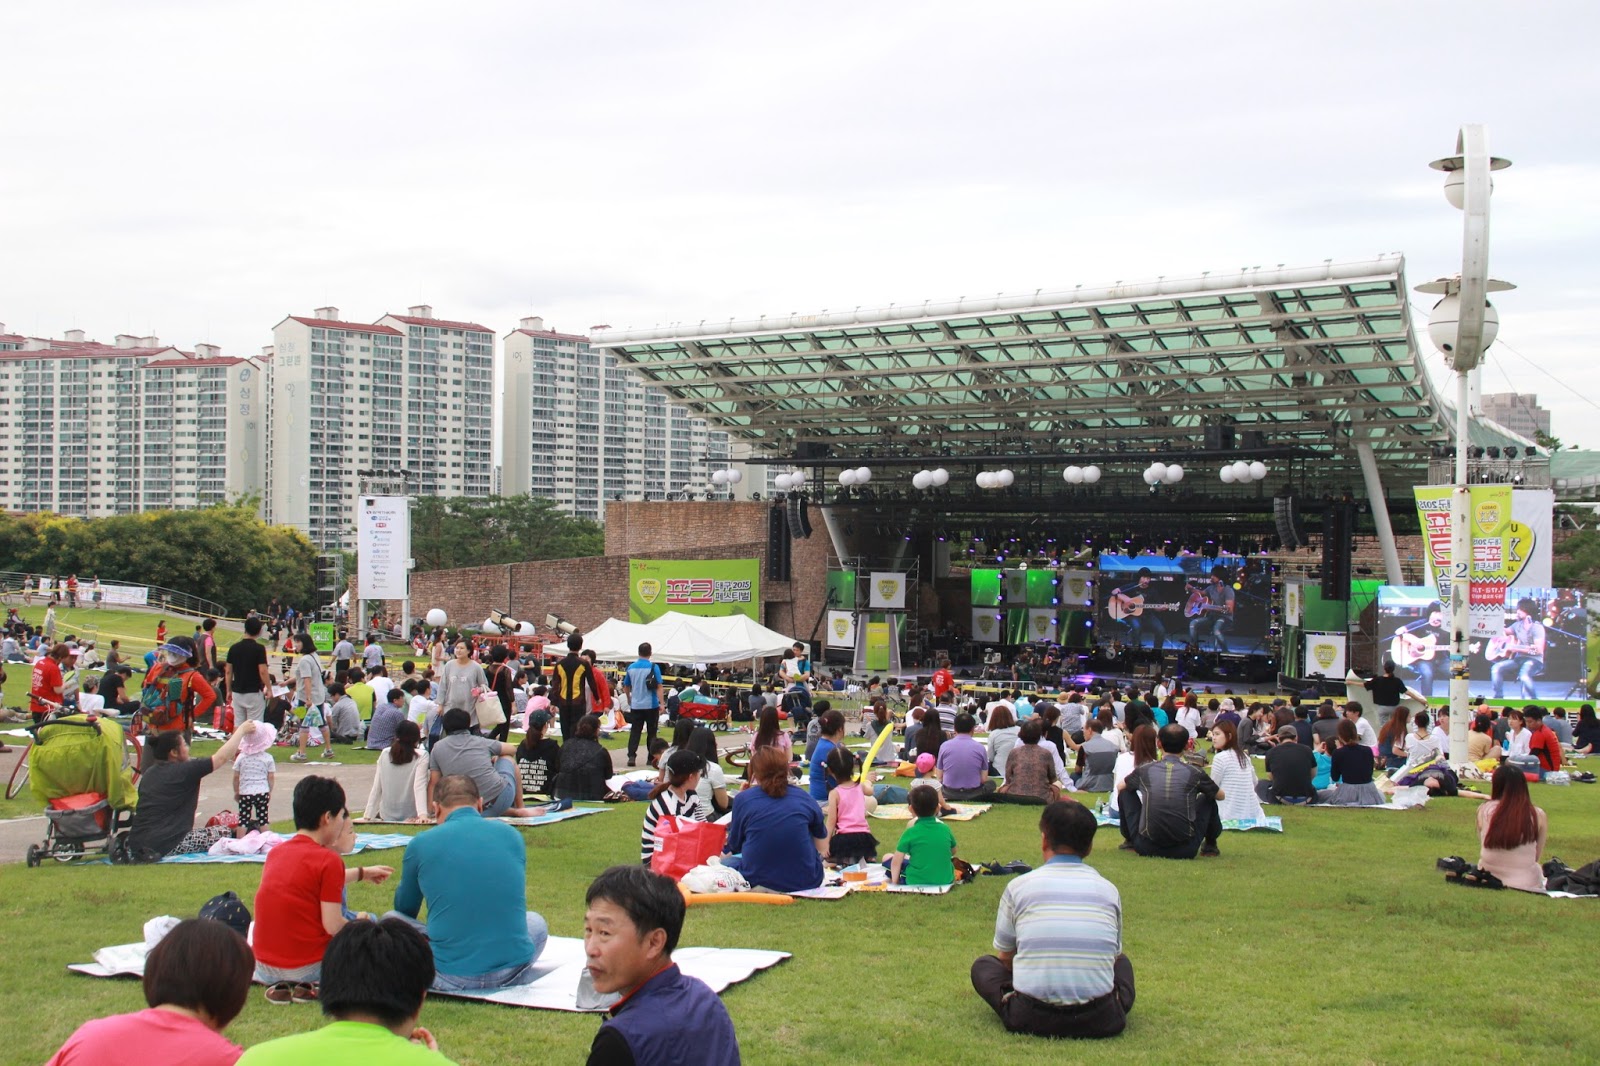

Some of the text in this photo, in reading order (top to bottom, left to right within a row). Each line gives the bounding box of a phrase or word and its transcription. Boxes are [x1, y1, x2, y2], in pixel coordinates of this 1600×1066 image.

[1455, 562, 1468, 579] 2
[715, 581, 751, 590] 대구 2015
[715, 591, 750, 602] 페스티벌
